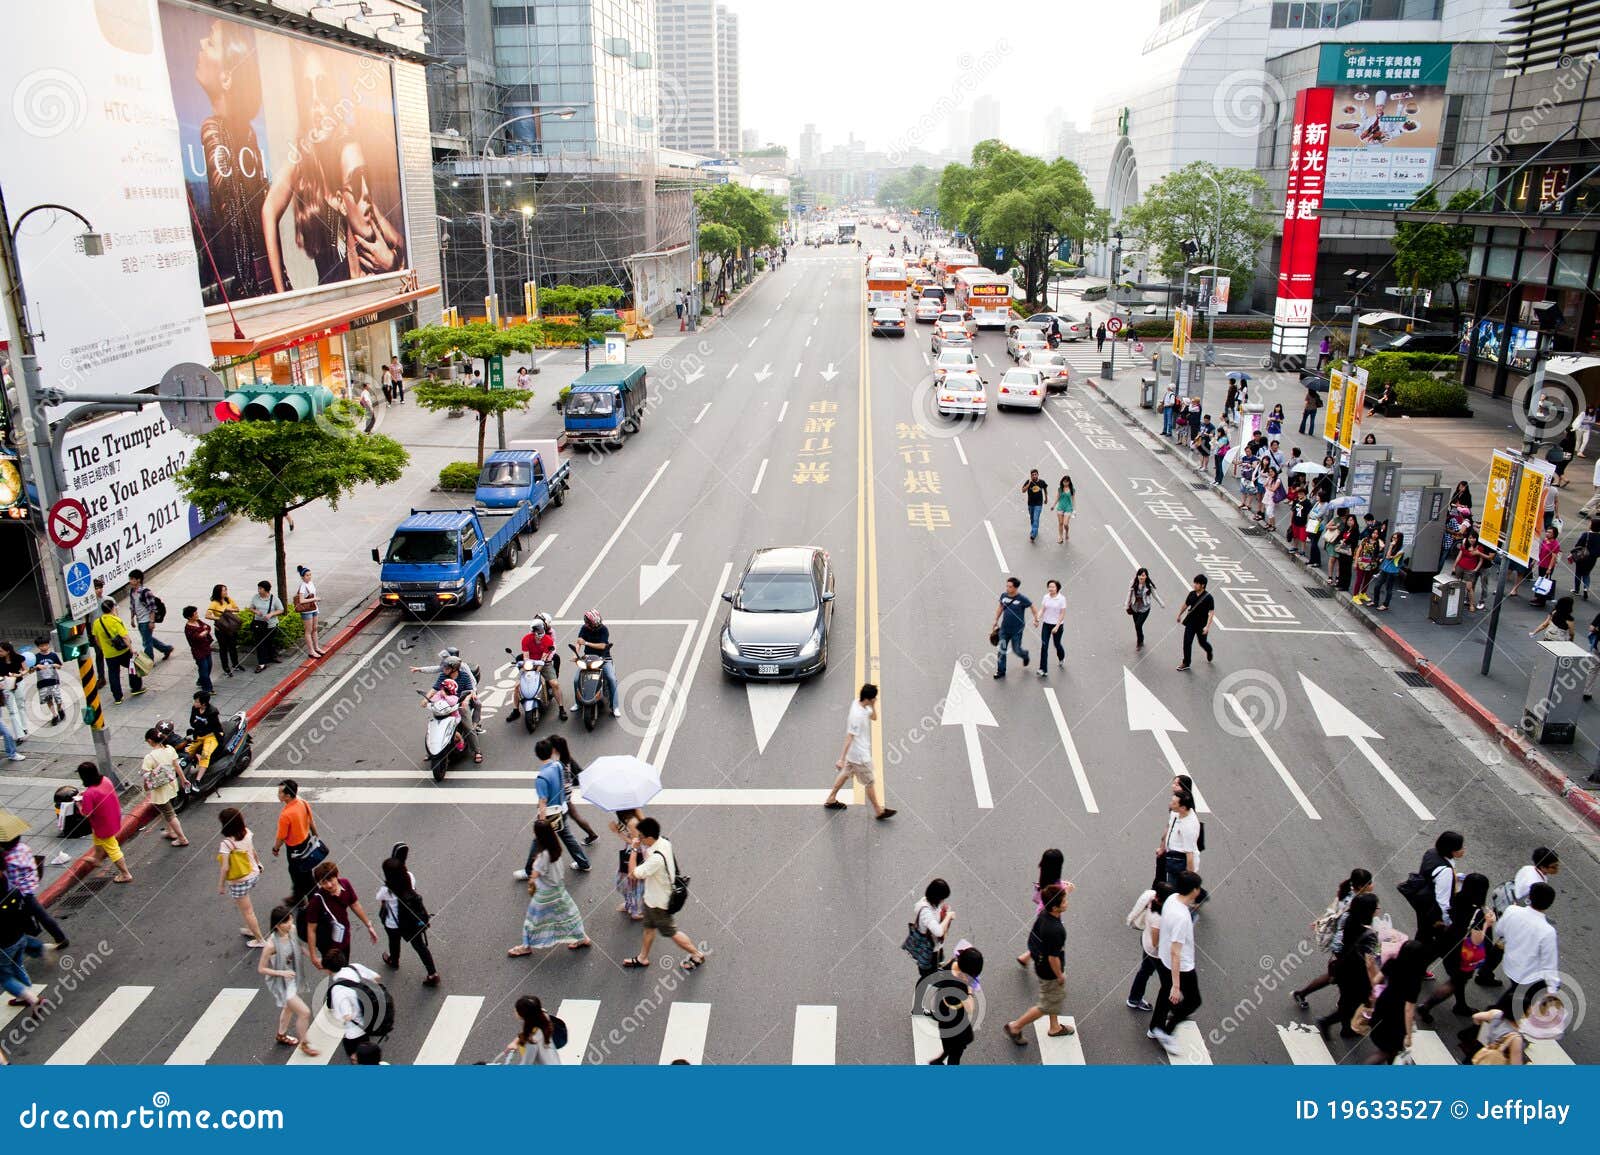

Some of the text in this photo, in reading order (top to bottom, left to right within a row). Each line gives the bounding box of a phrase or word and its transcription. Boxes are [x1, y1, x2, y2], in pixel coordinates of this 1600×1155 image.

[104, 101, 131, 122] HTC
[186, 144, 269, 180] UCCI
[1284, 123, 1302, 220] 新光三越
[1297, 122, 1328, 220] 新光三越
[68, 417, 165, 472] The Trumpet
[895, 422, 951, 531] 禁行機車
[82, 451, 185, 520] Are You Ready?
[87, 534, 120, 570] May
[123, 521, 146, 551] 21,
[148, 500, 180, 535] 2011
[1128, 477, 1302, 624] 公車停靠區
